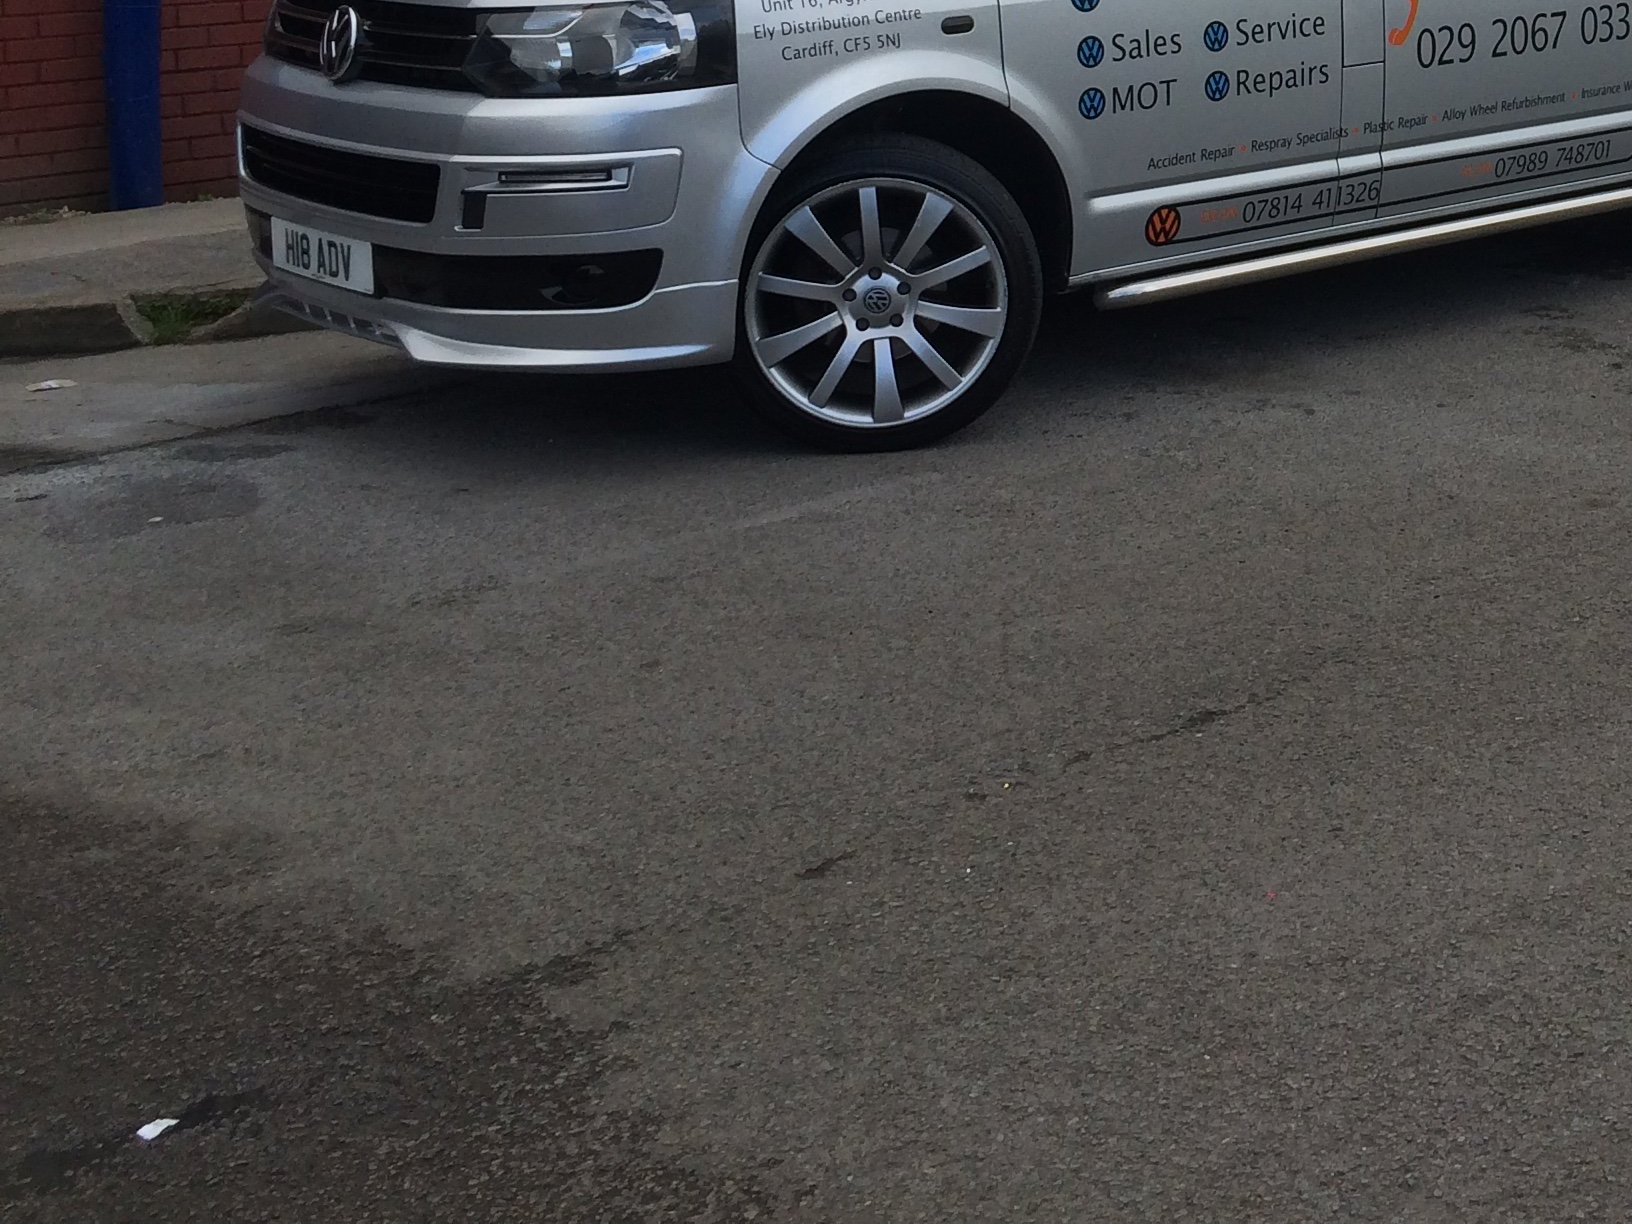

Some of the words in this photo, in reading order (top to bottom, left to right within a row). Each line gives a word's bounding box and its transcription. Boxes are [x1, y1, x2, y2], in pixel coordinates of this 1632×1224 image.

[754, 24, 775, 40] Ely
[781, 14, 870, 37] Distribution
[874, 7, 922, 26] Centre
[1236, 13, 1326, 47] Service
[1416, 22, 1477, 69] 029
[1491, 10, 1567, 59] 2067
[781, 42, 839, 62] Cardiff,
[843, 35, 871, 53] CF5
[877, 33, 901, 50] 5NJ
[1111, 29, 1182, 62] Sales
[1112, 79, 1178, 114] MOT
[1236, 61, 1330, 98] Repairs
[1147, 151, 1196, 171] Accident
[1200, 144, 1235, 163] Repair
[1251, 136, 1293, 154] Respray
[1296, 126, 1349, 147] Specialists
[1363, 118, 1395, 135] Plastic
[1398, 115, 1428, 129] Repair
[1442, 108, 1466, 122] Alloy
[1469, 101, 1498, 116] Wheel
[1501, 92, 1566, 112] Refurbishment
[1581, 84, 1621, 99] Insurance
[1494, 150, 1548, 178] 07989
[1555, 139, 1611, 168] 748701
[1242, 192, 1303, 224] 07814
[1311, 179, 1380, 211] 411326
[285, 227, 311, 270] H18
[317, 237, 351, 282] ADV
